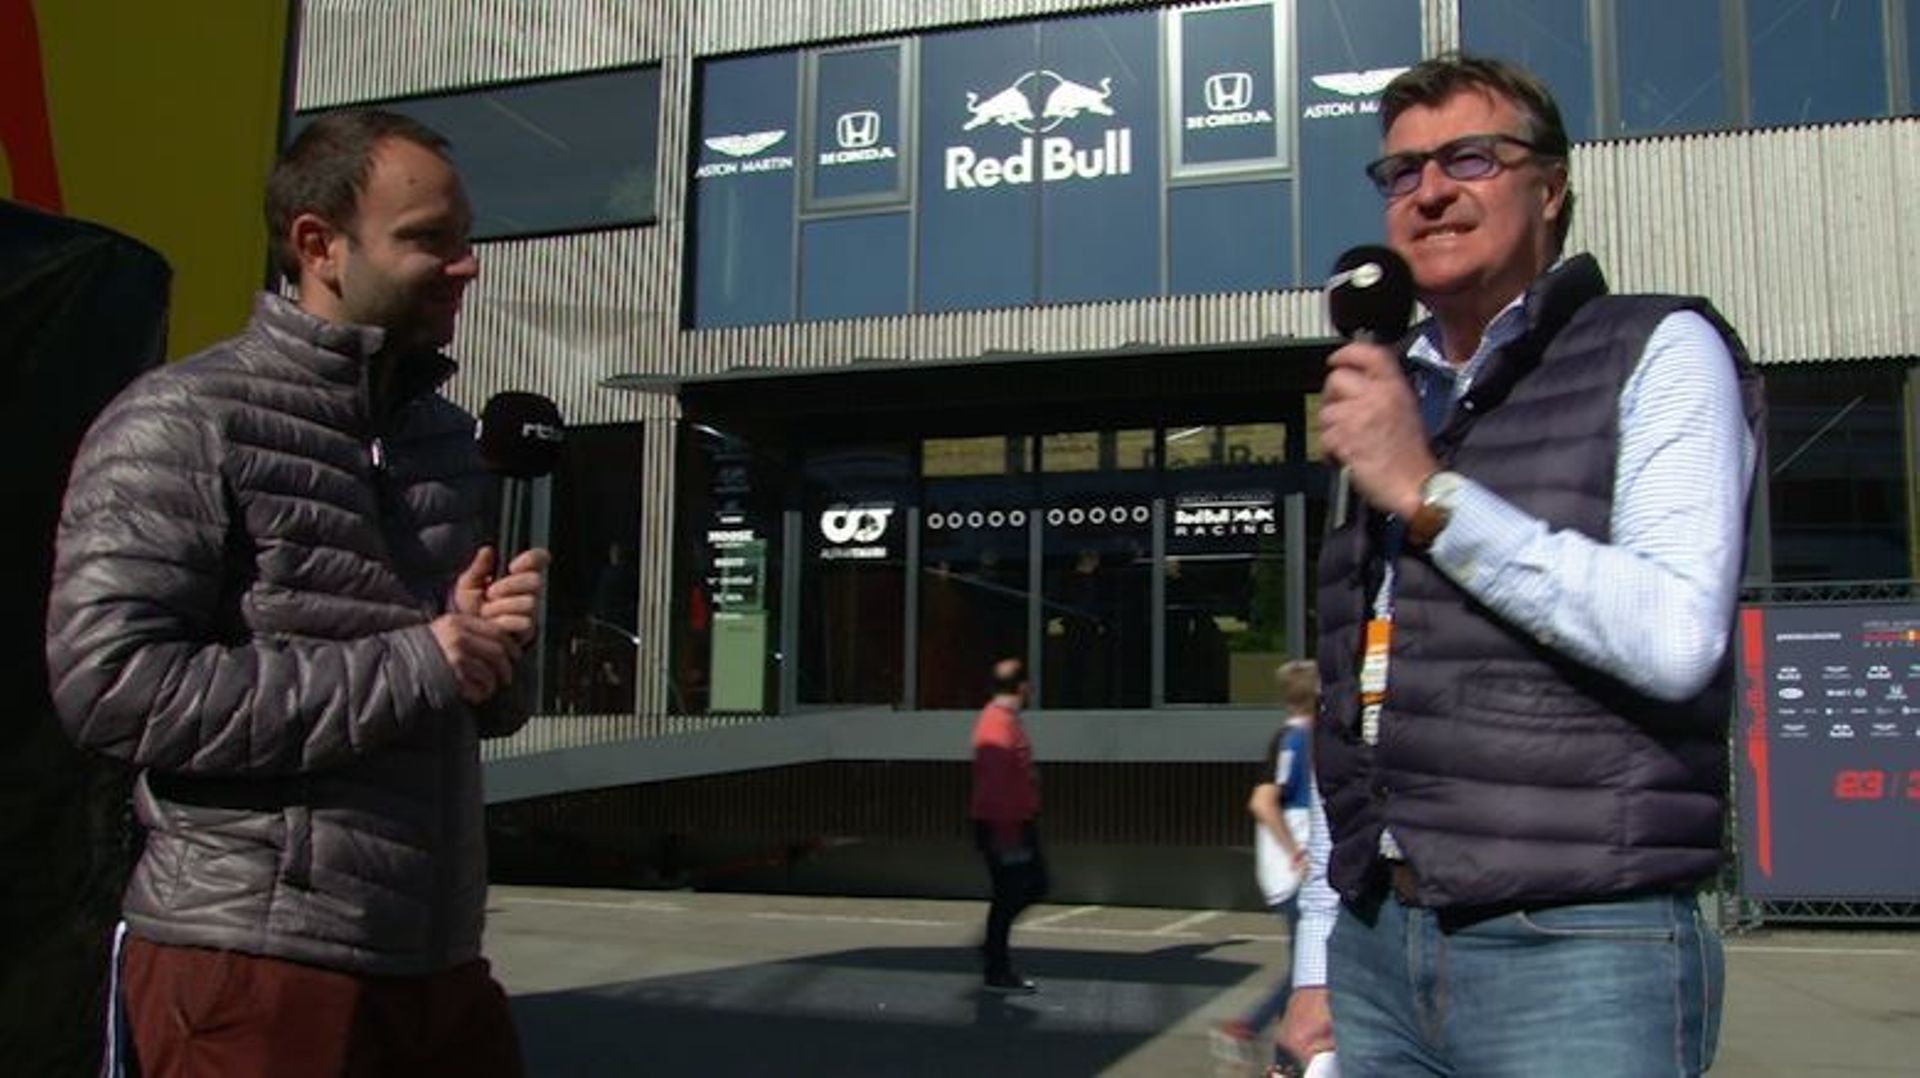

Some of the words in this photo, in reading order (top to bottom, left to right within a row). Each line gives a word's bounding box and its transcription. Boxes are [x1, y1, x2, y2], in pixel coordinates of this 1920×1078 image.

[1186, 109, 1272, 129] HONDA
[1304, 103, 1355, 118] ASTON
[819, 147, 896, 165] HONDA
[945, 136, 1034, 190] Red
[1042, 128, 1131, 181] Bull
[695, 162, 738, 178] ASTON
[741, 156, 793, 173] MARTIN
[1175, 508, 1204, 524] Red
[1175, 523, 1276, 537] RACING
